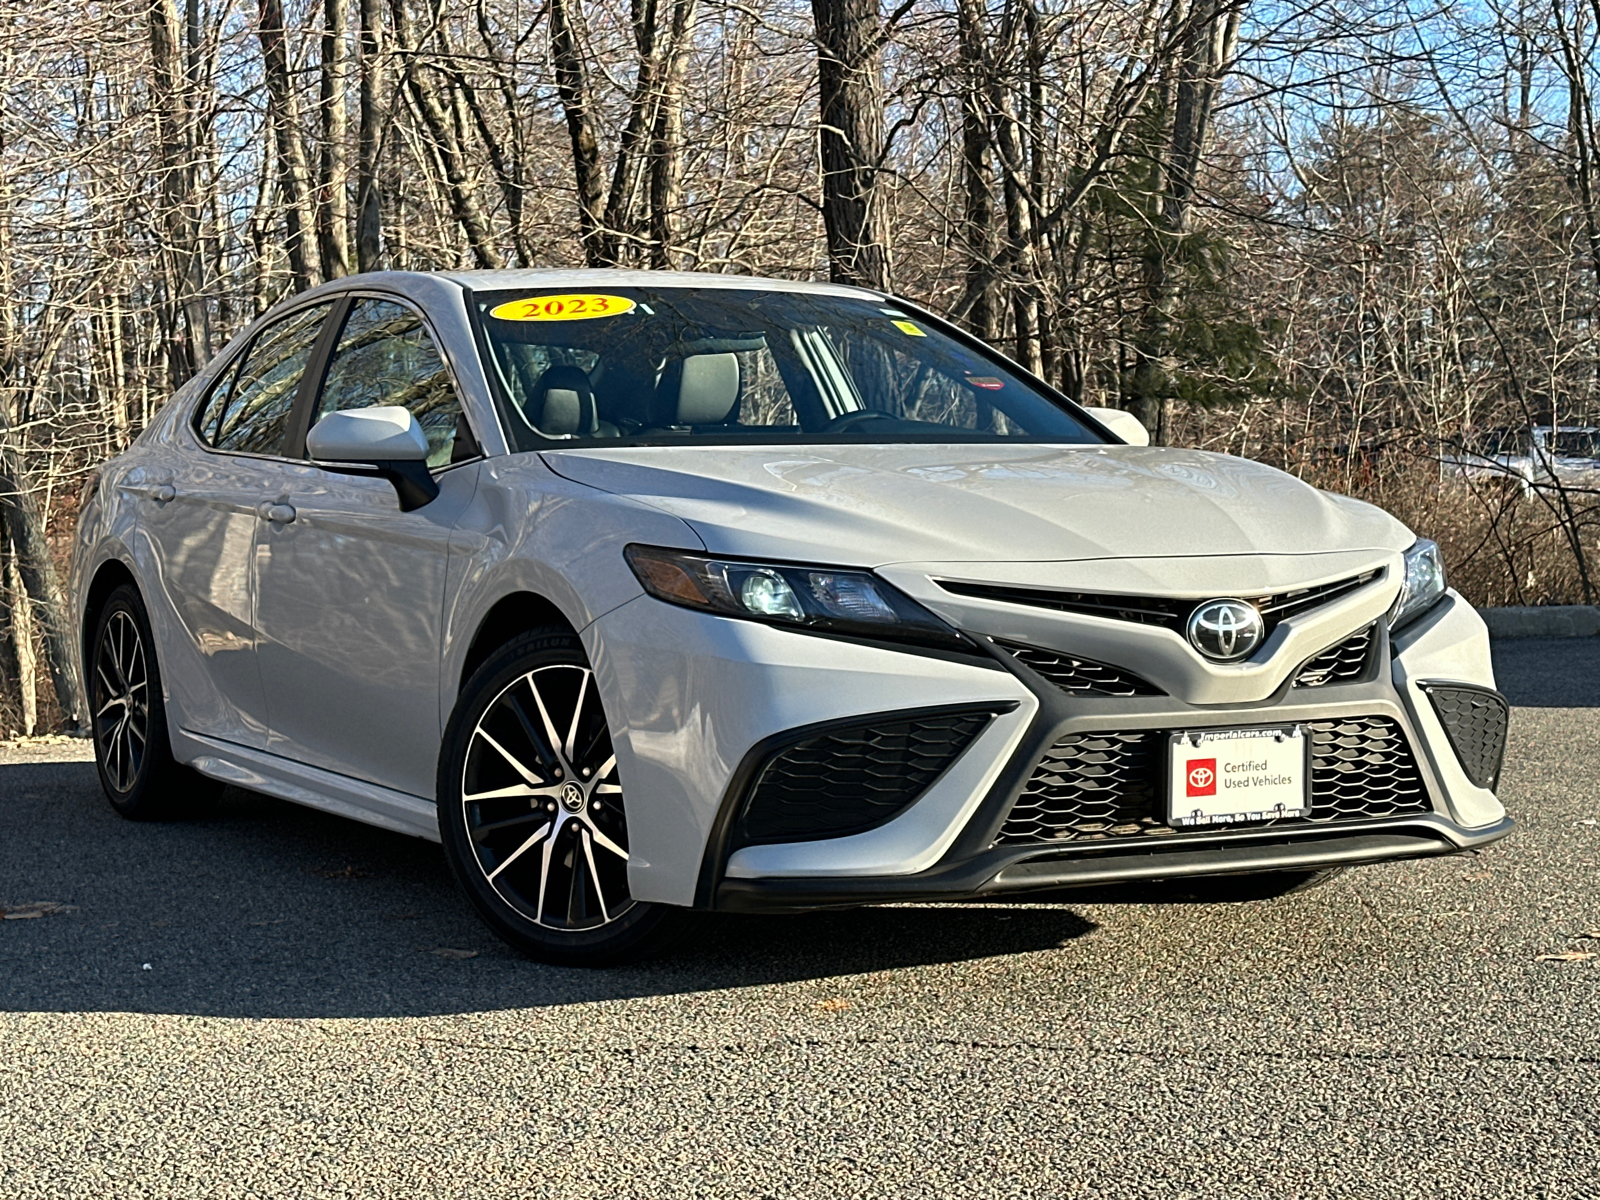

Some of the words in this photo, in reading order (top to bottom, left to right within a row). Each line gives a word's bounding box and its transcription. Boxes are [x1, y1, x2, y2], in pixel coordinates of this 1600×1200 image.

[522, 298, 609, 317] 2023
[517, 638, 570, 655] SAILUN
[1224, 760, 1267, 773] Certified
[1224, 776, 1249, 788] Used
[1252, 774, 1292, 787] Vehicles
[1182, 817, 1195, 826] We
[1196, 816, 1210, 825] Sell
[1235, 813, 1246, 822] So
[1246, 812, 1261, 821] You
[1262, 811, 1280, 820] Save
[1281, 809, 1300, 818] More
